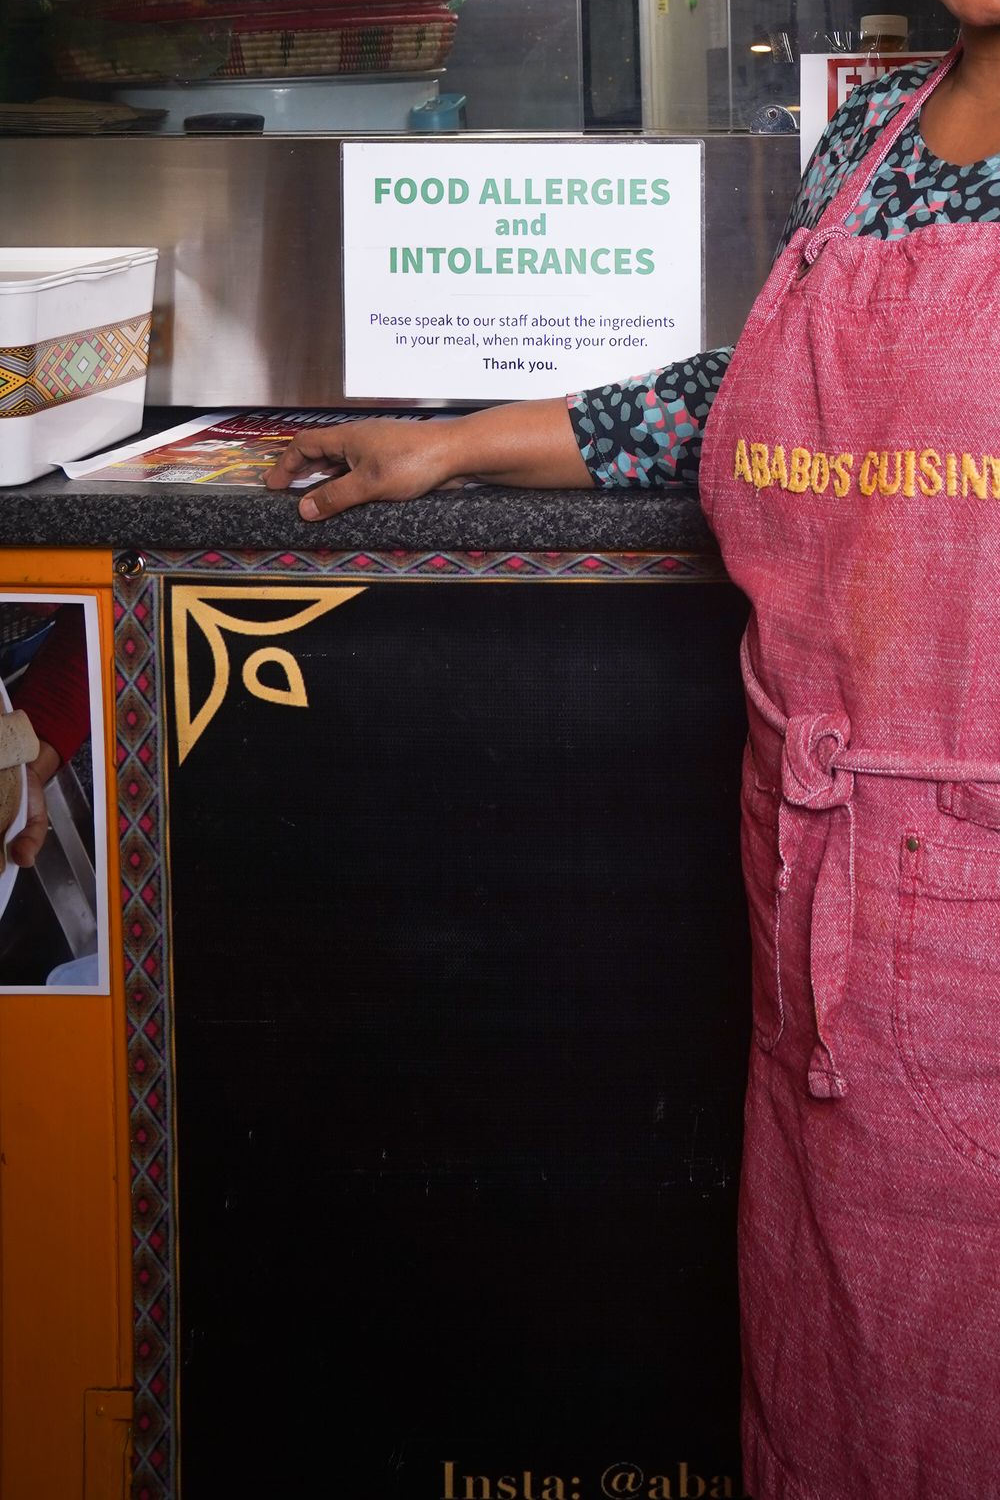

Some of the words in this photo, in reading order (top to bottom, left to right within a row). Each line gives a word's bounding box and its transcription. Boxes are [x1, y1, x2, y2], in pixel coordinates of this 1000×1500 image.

[374, 177, 470, 205] FOOD
[479, 177, 671, 206] ALLERGIES
[495, 212, 547, 236] and
[389, 246, 655, 276] INTOLERANCES
[370, 313, 412, 327] Please
[415, 314, 453, 329] speak
[457, 315, 470, 327] to
[473, 317, 495, 327] our
[499, 314, 527, 327] staff
[531, 314, 570, 328] about
[574, 314, 595, 328] the
[599, 315, 675, 331] ingredients
[395, 332, 408, 345] in
[411, 336, 440, 349] your
[443, 332, 479, 348] meal,
[483, 333, 519, 347] when
[522, 334, 572, 350] making
[575, 338, 606, 350] your
[608, 334, 648, 347] order.
[483, 357, 526, 370] Thank
[529, 360, 558, 374] you.
[440, 1460, 582, 1500] Insta:
